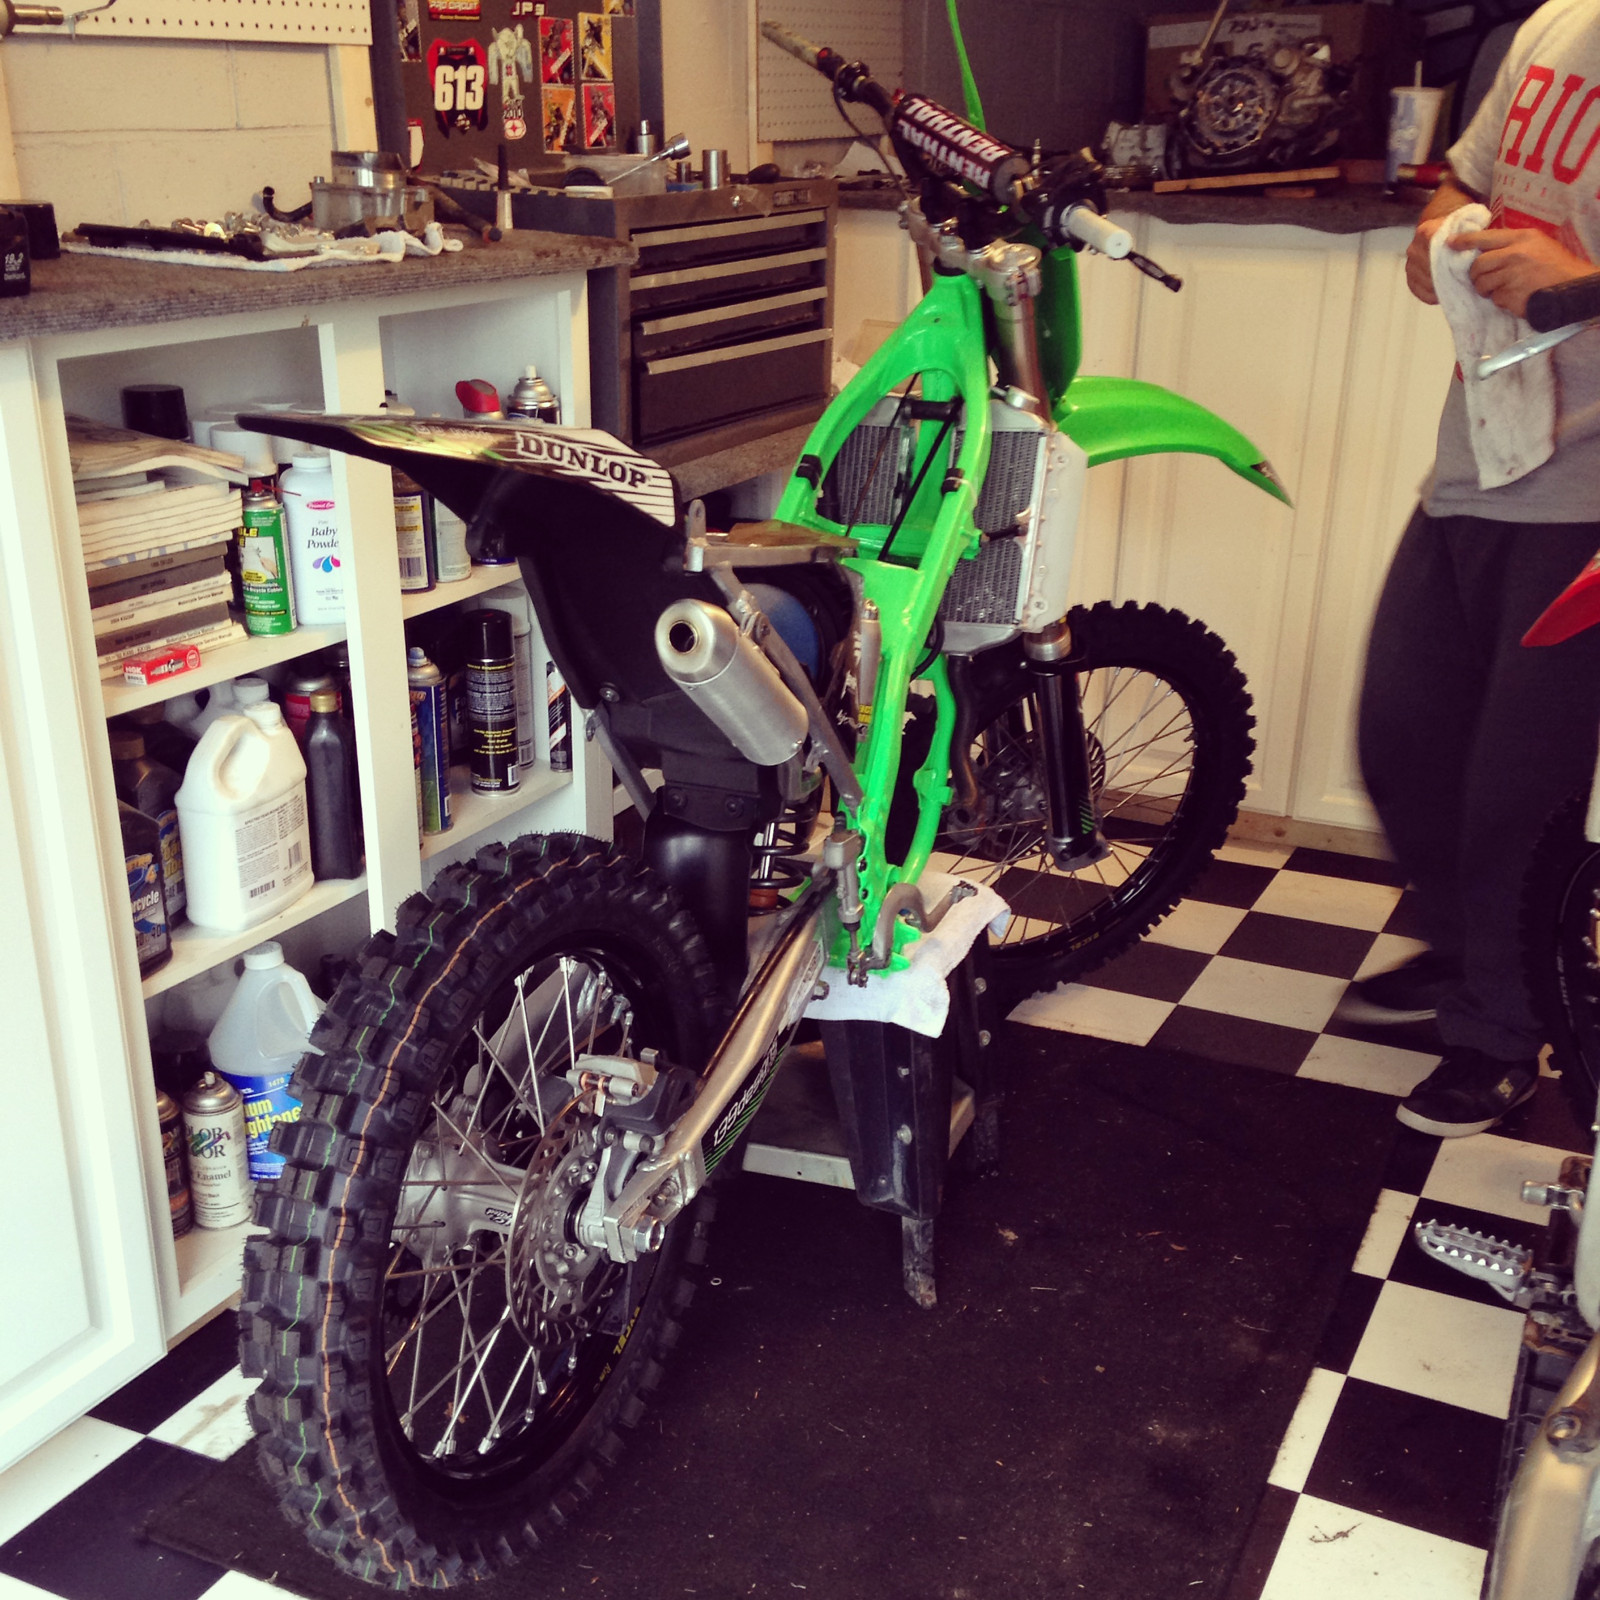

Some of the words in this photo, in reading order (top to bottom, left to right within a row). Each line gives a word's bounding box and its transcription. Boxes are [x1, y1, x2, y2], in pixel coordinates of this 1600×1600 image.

[434, 65, 485, 111] 613
[905, 97, 1009, 162] RENTHAL
[898, 119, 991, 189] RENTHAL
[519, 433, 648, 489] DUNLOP
[307, 539, 340, 549] Powde
[311, 527, 338, 538] Baby
[132, 890, 160, 912] rcycle
[197, 1171, 231, 1180] Enamel
